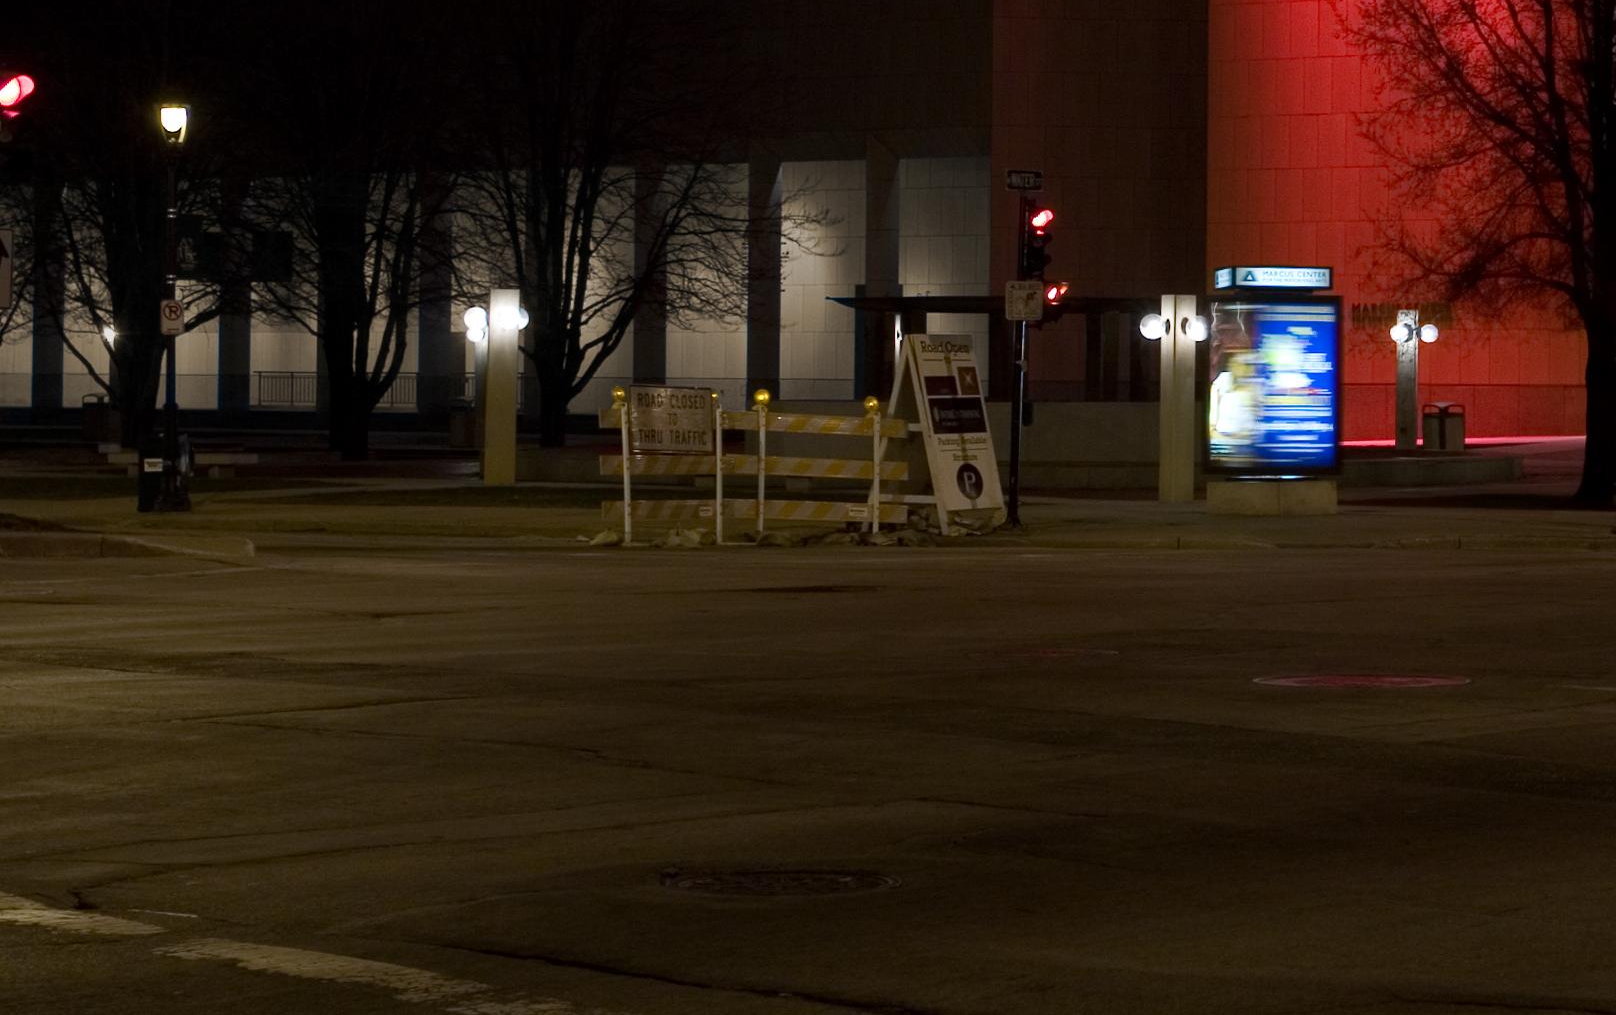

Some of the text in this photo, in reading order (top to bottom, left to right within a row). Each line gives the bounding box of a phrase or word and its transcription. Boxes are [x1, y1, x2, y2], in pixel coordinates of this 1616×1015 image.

[920, 341, 970, 356] Road Open
[637, 392, 706, 409] ROAD CLOSED
[667, 412, 679, 426] TO
[639, 429, 707, 445] THRU TRAFFIC
